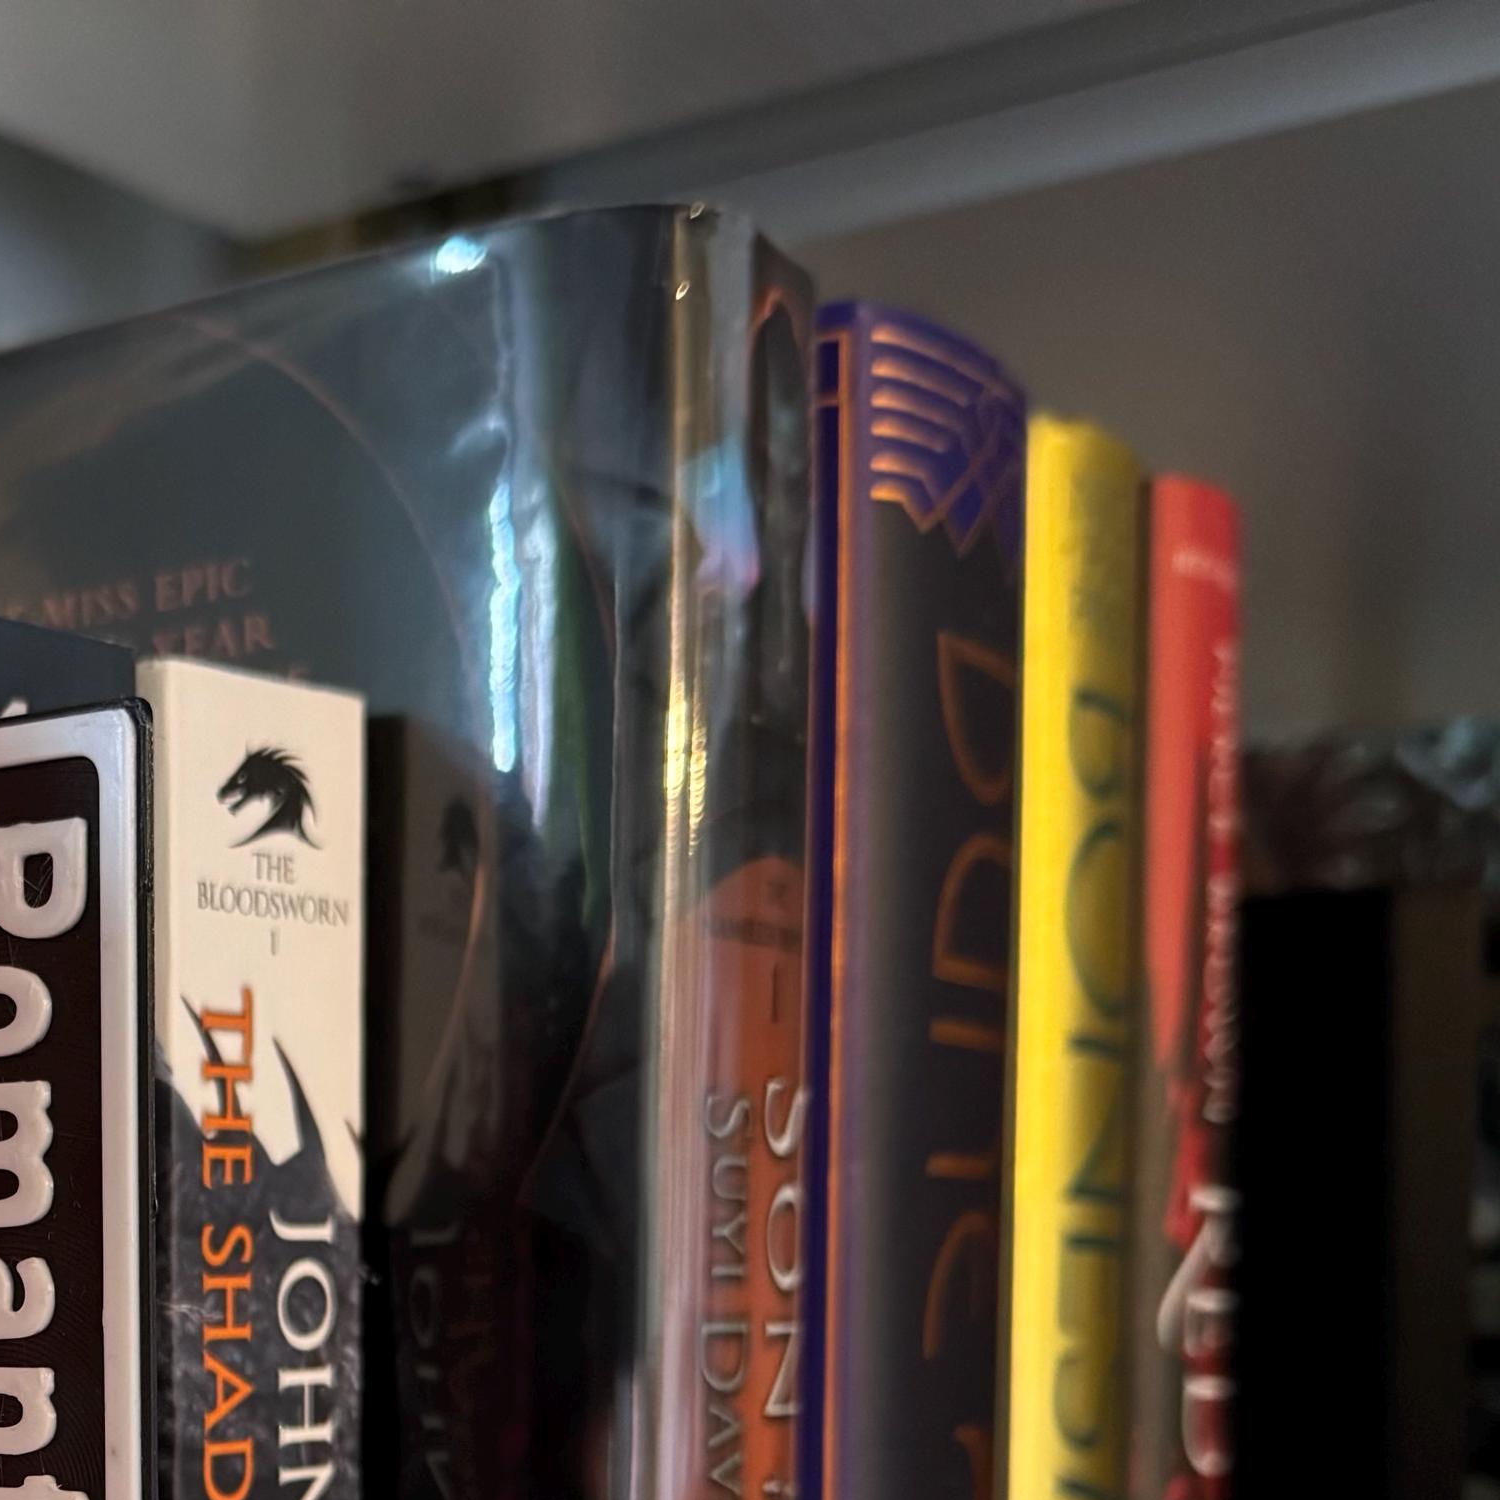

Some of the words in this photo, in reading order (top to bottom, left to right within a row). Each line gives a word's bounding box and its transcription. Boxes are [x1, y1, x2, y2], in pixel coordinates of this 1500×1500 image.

[154, 559, 254, 612] EPIC
[196, 881, 350, 926] BLOODSWORN
[254, 852, 295, 884] THE
[201, 985, 254, 1189] THE
[703, 1092, 752, 1282] SUYI
[763, 1076, 808, 1419] SON
